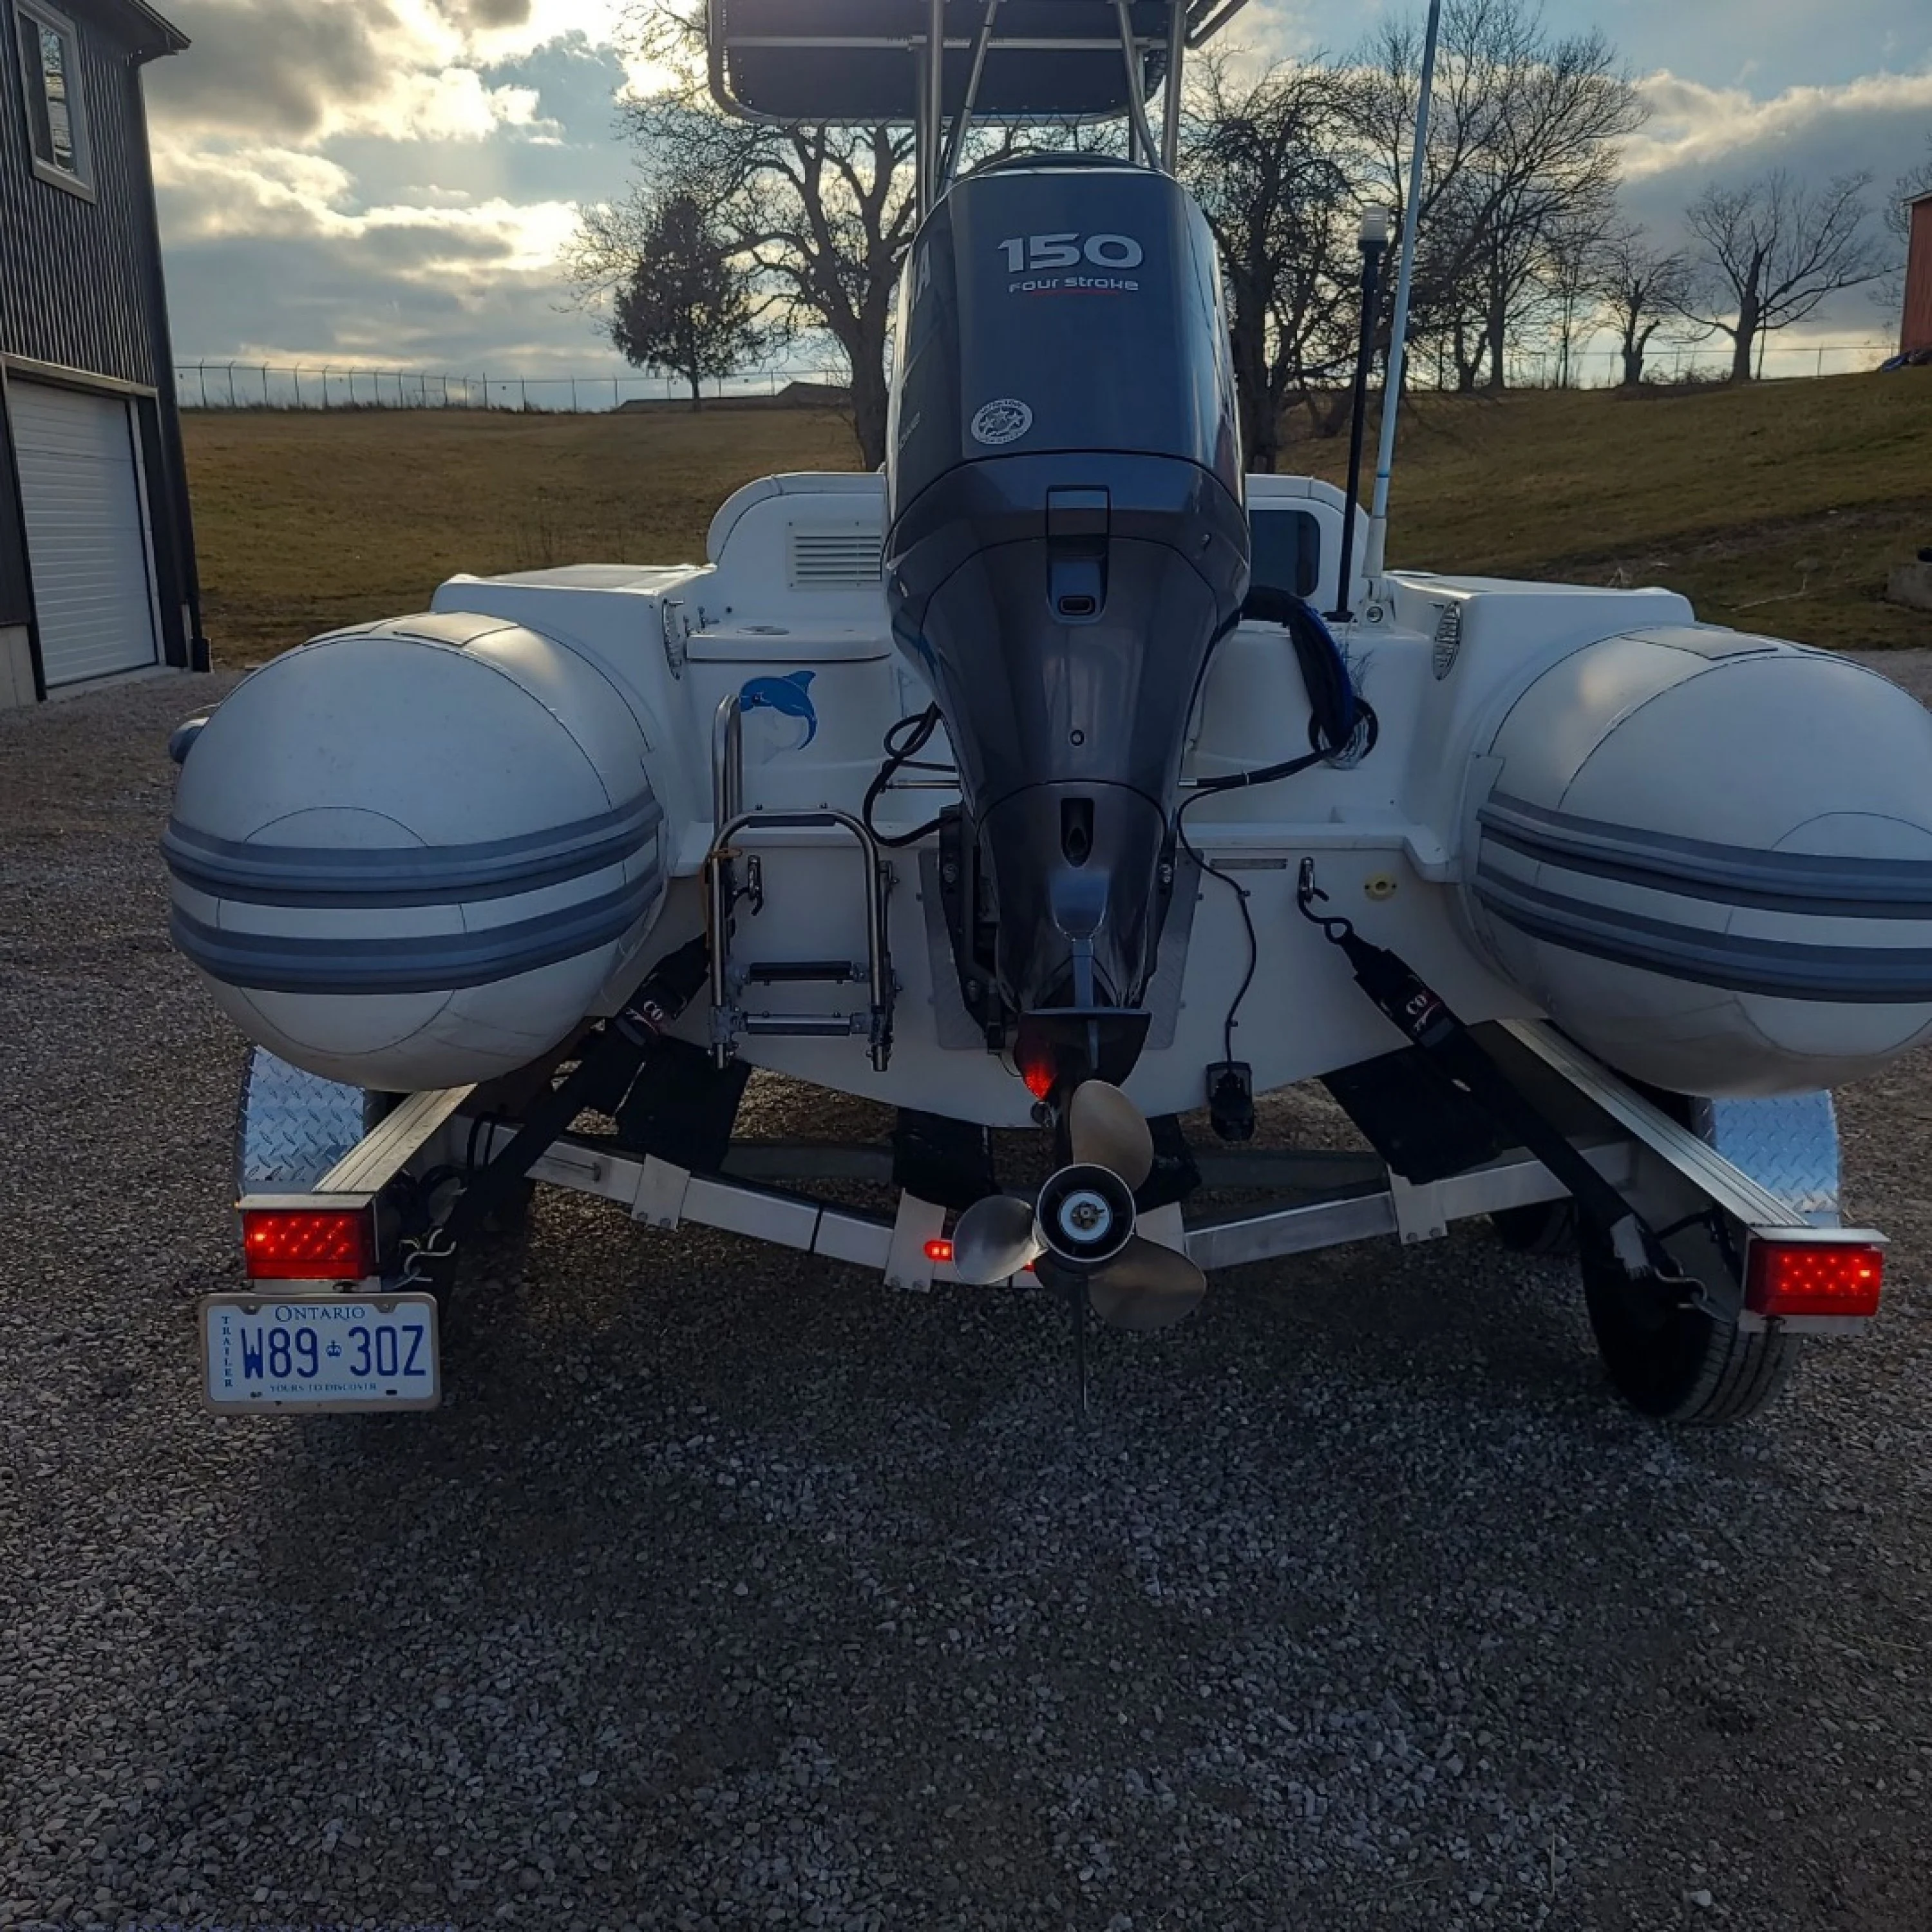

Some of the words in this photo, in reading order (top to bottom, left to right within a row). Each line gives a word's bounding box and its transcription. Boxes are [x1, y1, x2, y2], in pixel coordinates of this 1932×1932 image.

[998, 232, 1143, 272] 150
[275, 1305, 366, 1322] ONTARIO
[241, 1327, 319, 1379] W89
